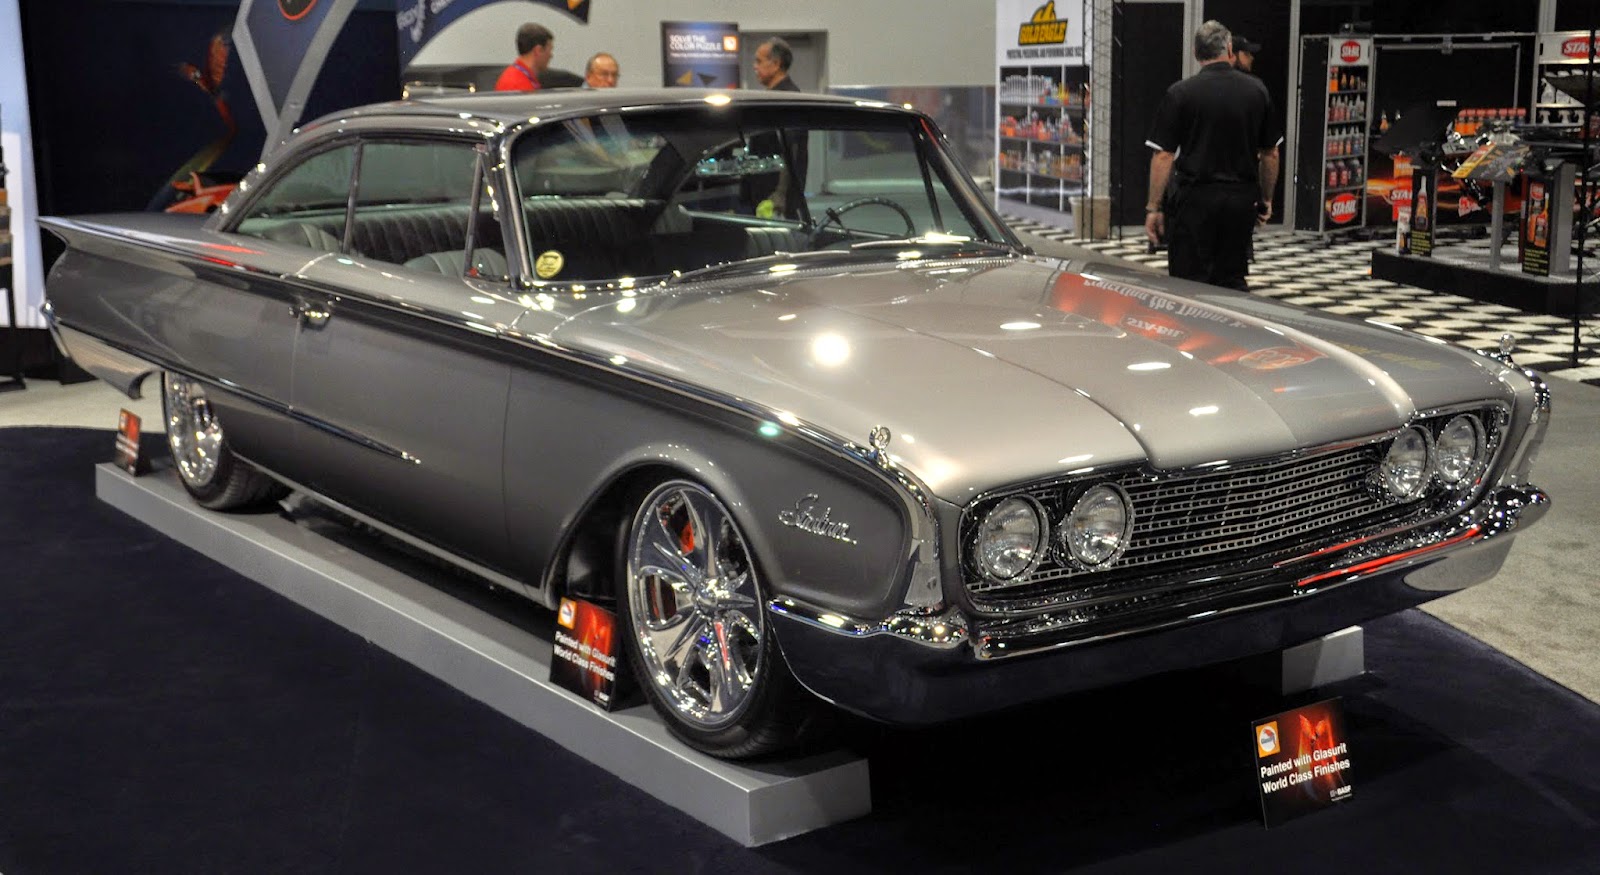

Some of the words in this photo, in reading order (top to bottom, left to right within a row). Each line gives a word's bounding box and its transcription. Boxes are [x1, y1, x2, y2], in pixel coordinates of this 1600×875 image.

[669, 34, 691, 42] SOLVE
[692, 34, 706, 42] THE
[1020, 24, 1039, 43] GOLD
[1039, 22, 1066, 42] EAGLE
[669, 42, 695, 50] COLOR
[1331, 199, 1357, 216] STA-BIL
[555, 630, 579, 650] Painted
[578, 642, 592, 656] with
[592, 646, 616, 668] Glasurit
[553, 643, 573, 661] World
[571, 652, 589, 669] Class
[589, 660, 615, 682] Finishes
[1260, 758, 1293, 778] Painted
[1293, 753, 1312, 767] with
[1313, 742, 1347, 761] Glasurit
[1262, 776, 1288, 794] World
[1288, 770, 1313, 785] Class
[1313, 759, 1350, 778] Finishes
[1337, 785, 1352, 796] BASF
